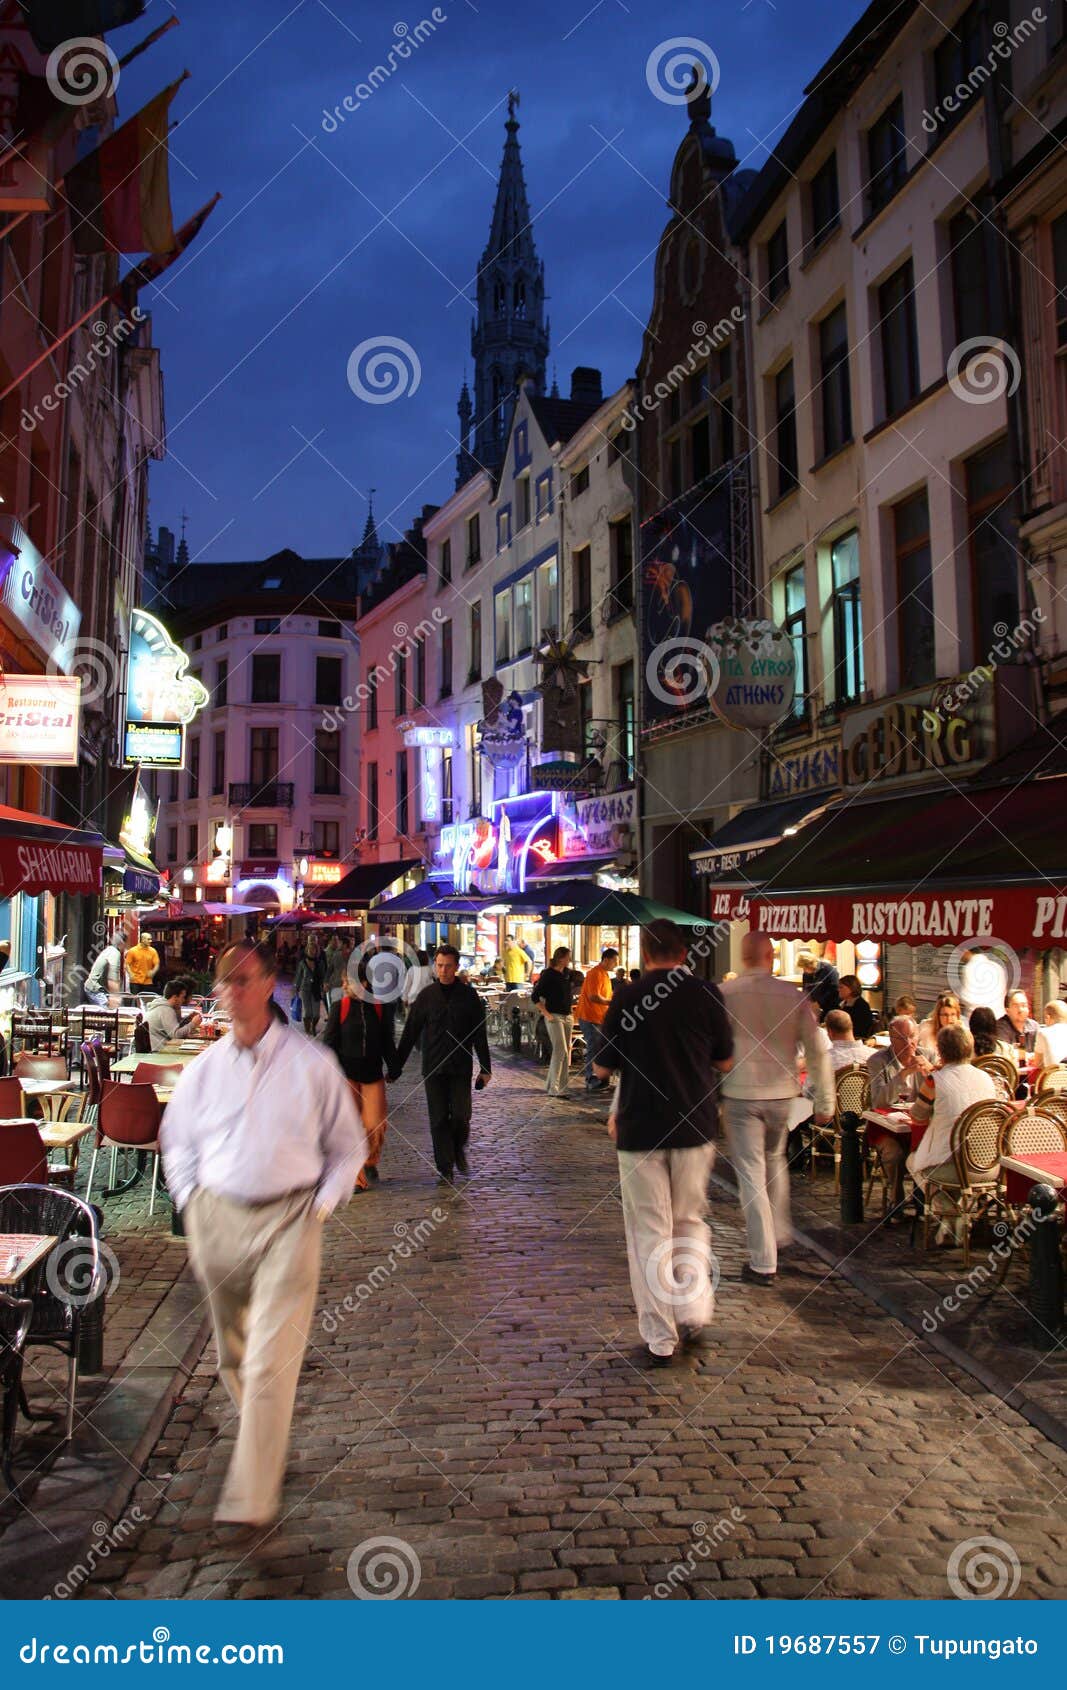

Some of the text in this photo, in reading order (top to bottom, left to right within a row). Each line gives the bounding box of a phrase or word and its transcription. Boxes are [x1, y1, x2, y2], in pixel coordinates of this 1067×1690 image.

[751, 658, 794, 677] GYROS
[8, 696, 57, 709] Restaurant
[726, 684, 785, 705] ATHENES
[17, 845, 94, 884] SHAWARMA
[714, 893, 731, 914] ICE
[758, 903, 828, 934] PIZZERIA
[851, 898, 994, 937] RISTORANTE
